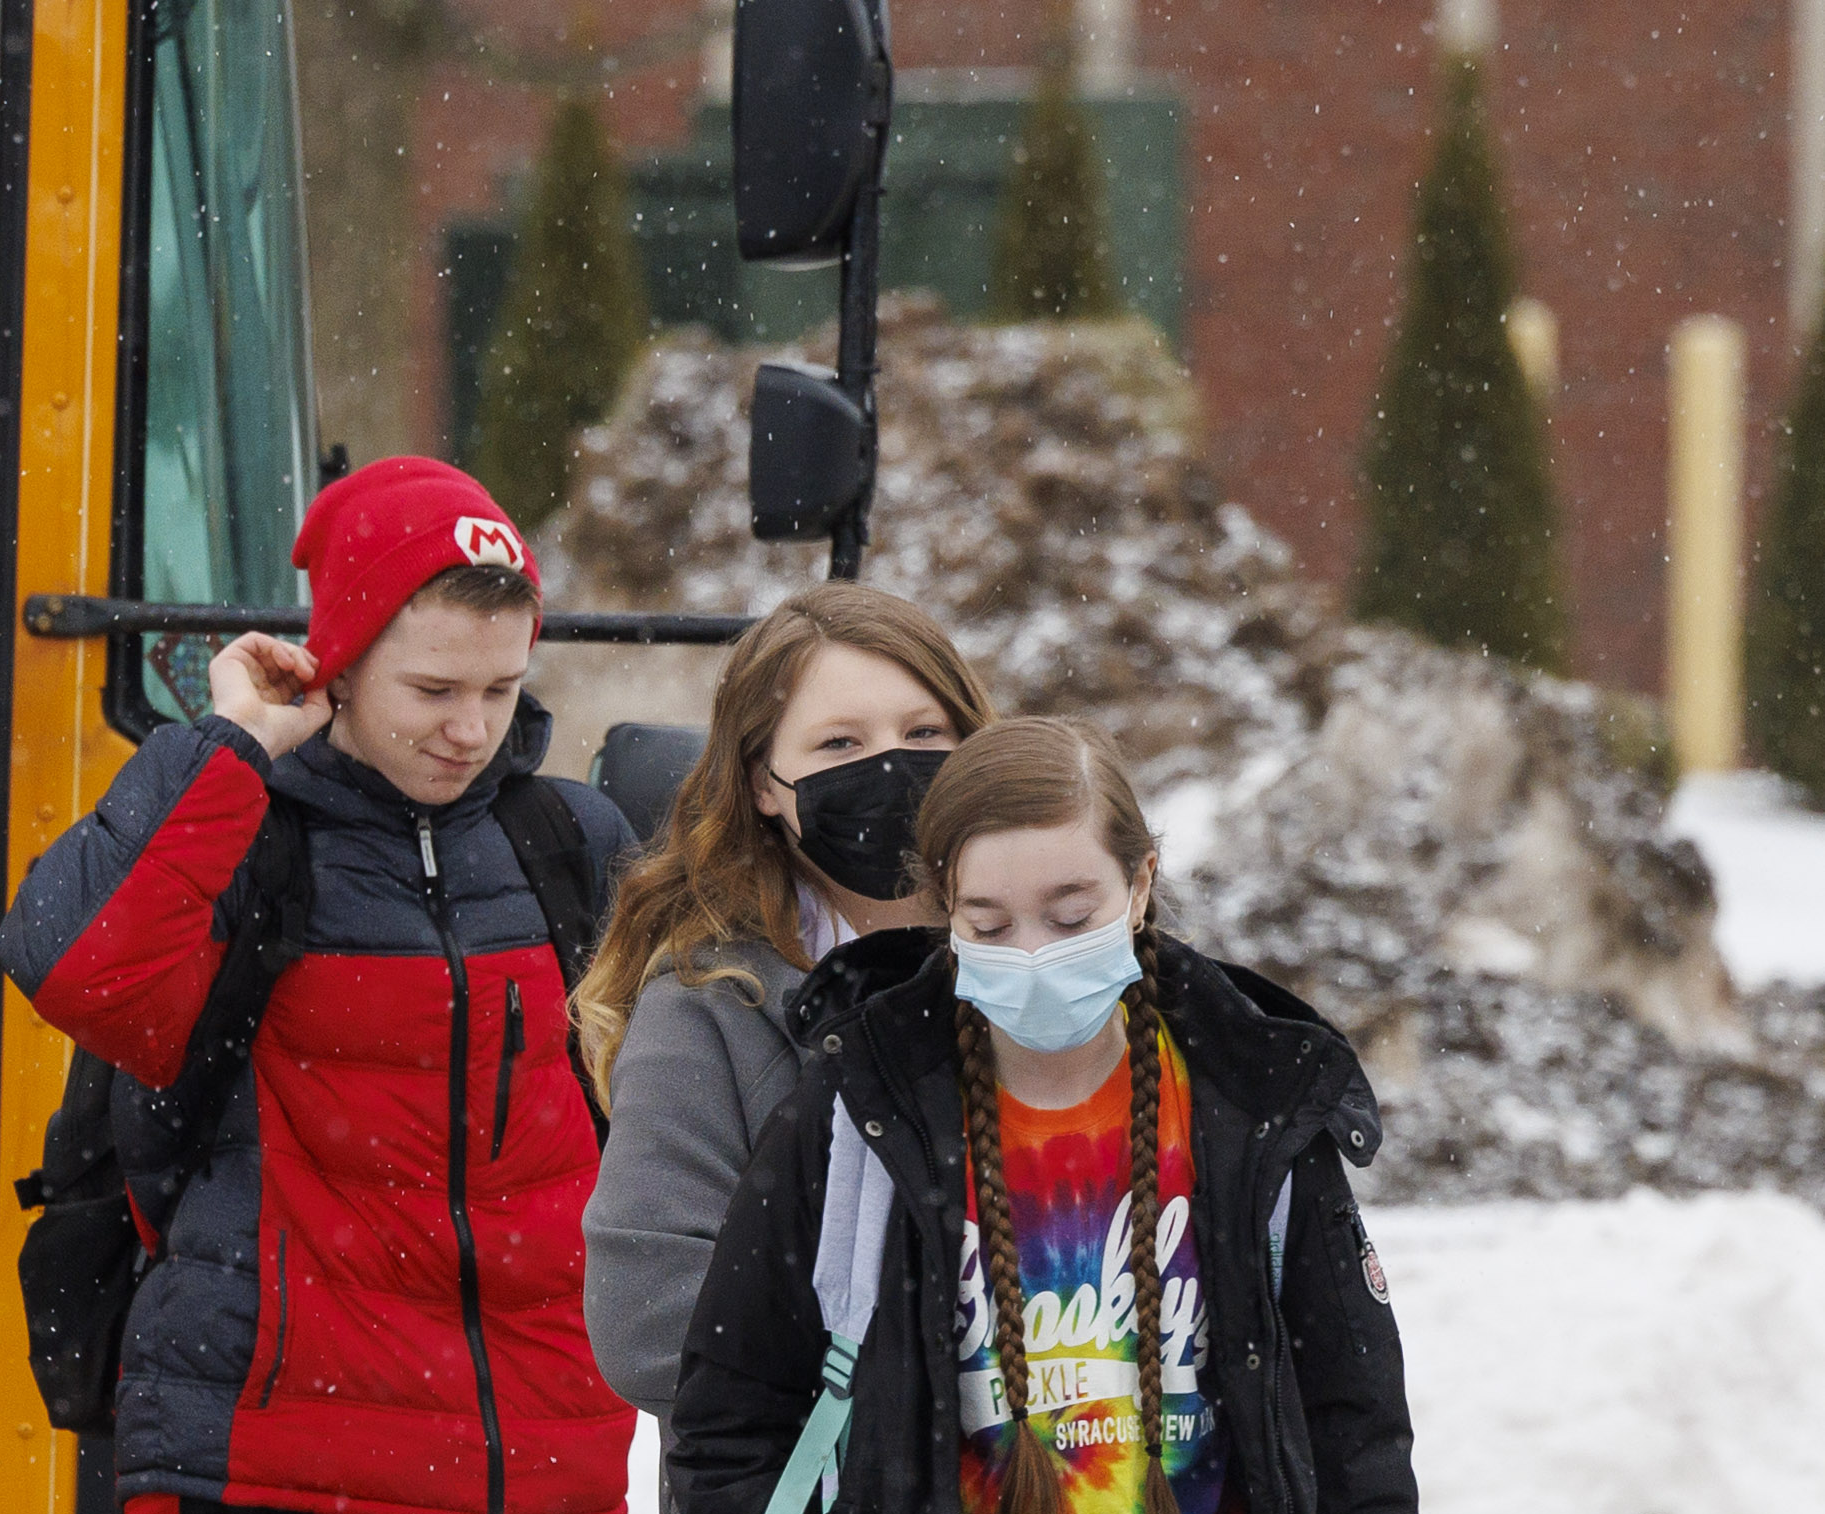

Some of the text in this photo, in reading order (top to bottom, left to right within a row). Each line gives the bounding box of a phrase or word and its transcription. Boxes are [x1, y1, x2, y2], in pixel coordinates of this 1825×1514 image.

[469, 524, 517, 564] M
[989, 1361, 1089, 1416] PCKLE
[1159, 1414, 1196, 1442] EW
